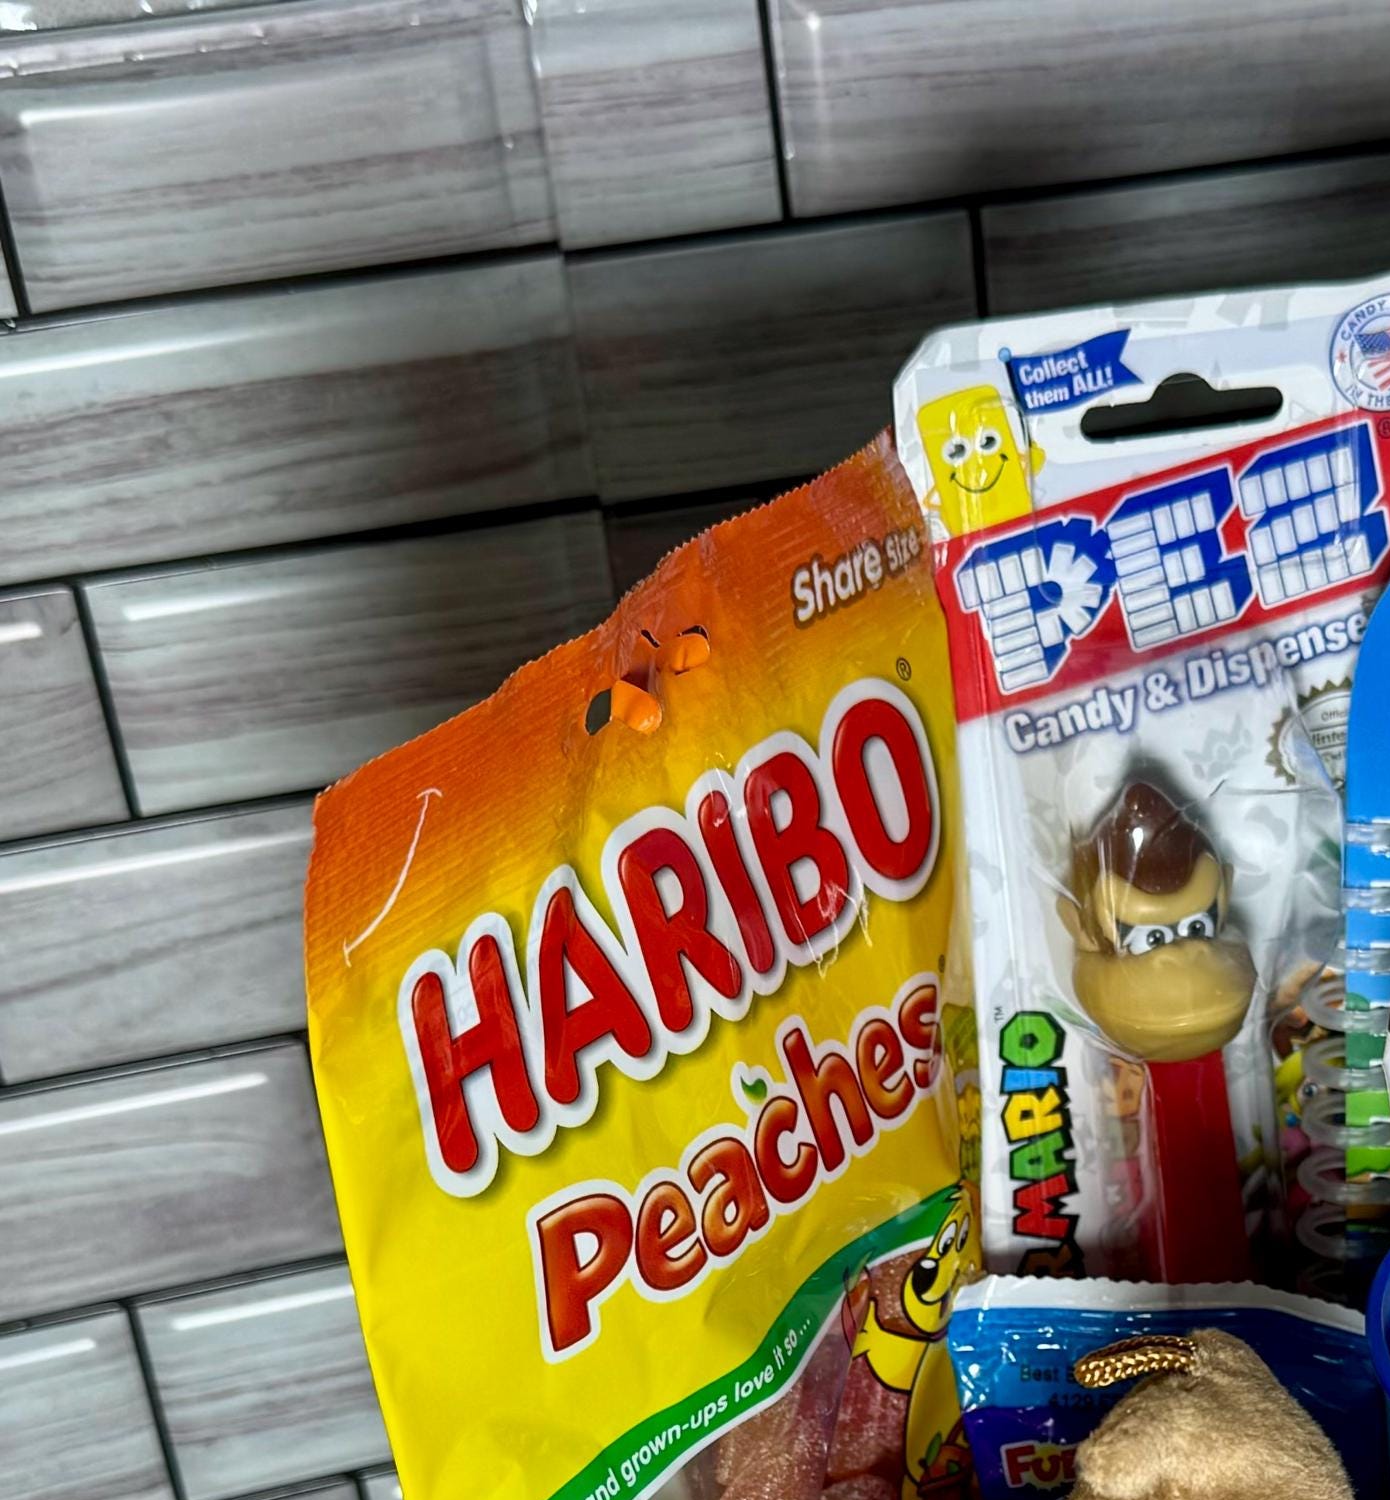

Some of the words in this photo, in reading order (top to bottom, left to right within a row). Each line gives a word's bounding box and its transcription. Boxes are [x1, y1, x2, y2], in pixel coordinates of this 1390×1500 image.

[1018, 350, 1089, 386] Collect
[1341, 301, 1385, 341] CANDY
[1025, 386, 1070, 409] them
[1072, 366, 1114, 396] ALL!
[1345, 384, 1364, 401] IN
[793, 542, 883, 622] Share
[885, 527, 920, 571] Size
[1003, 686, 1136, 755] Candy
[1144, 671, 1180, 711] &
[1185, 610, 1366, 701] Dispense
[408, 695, 934, 1176] HARIBO
[535, 982, 939, 1354] Peaches
[998, 1011, 1080, 1239] MARIO
[620, 1394, 728, 1486] grown-ups
[734, 1366, 775, 1403] love
[773, 1344, 784, 1370] it
[784, 1328, 798, 1356] so
[1020, 1364, 1060, 1383] Best
